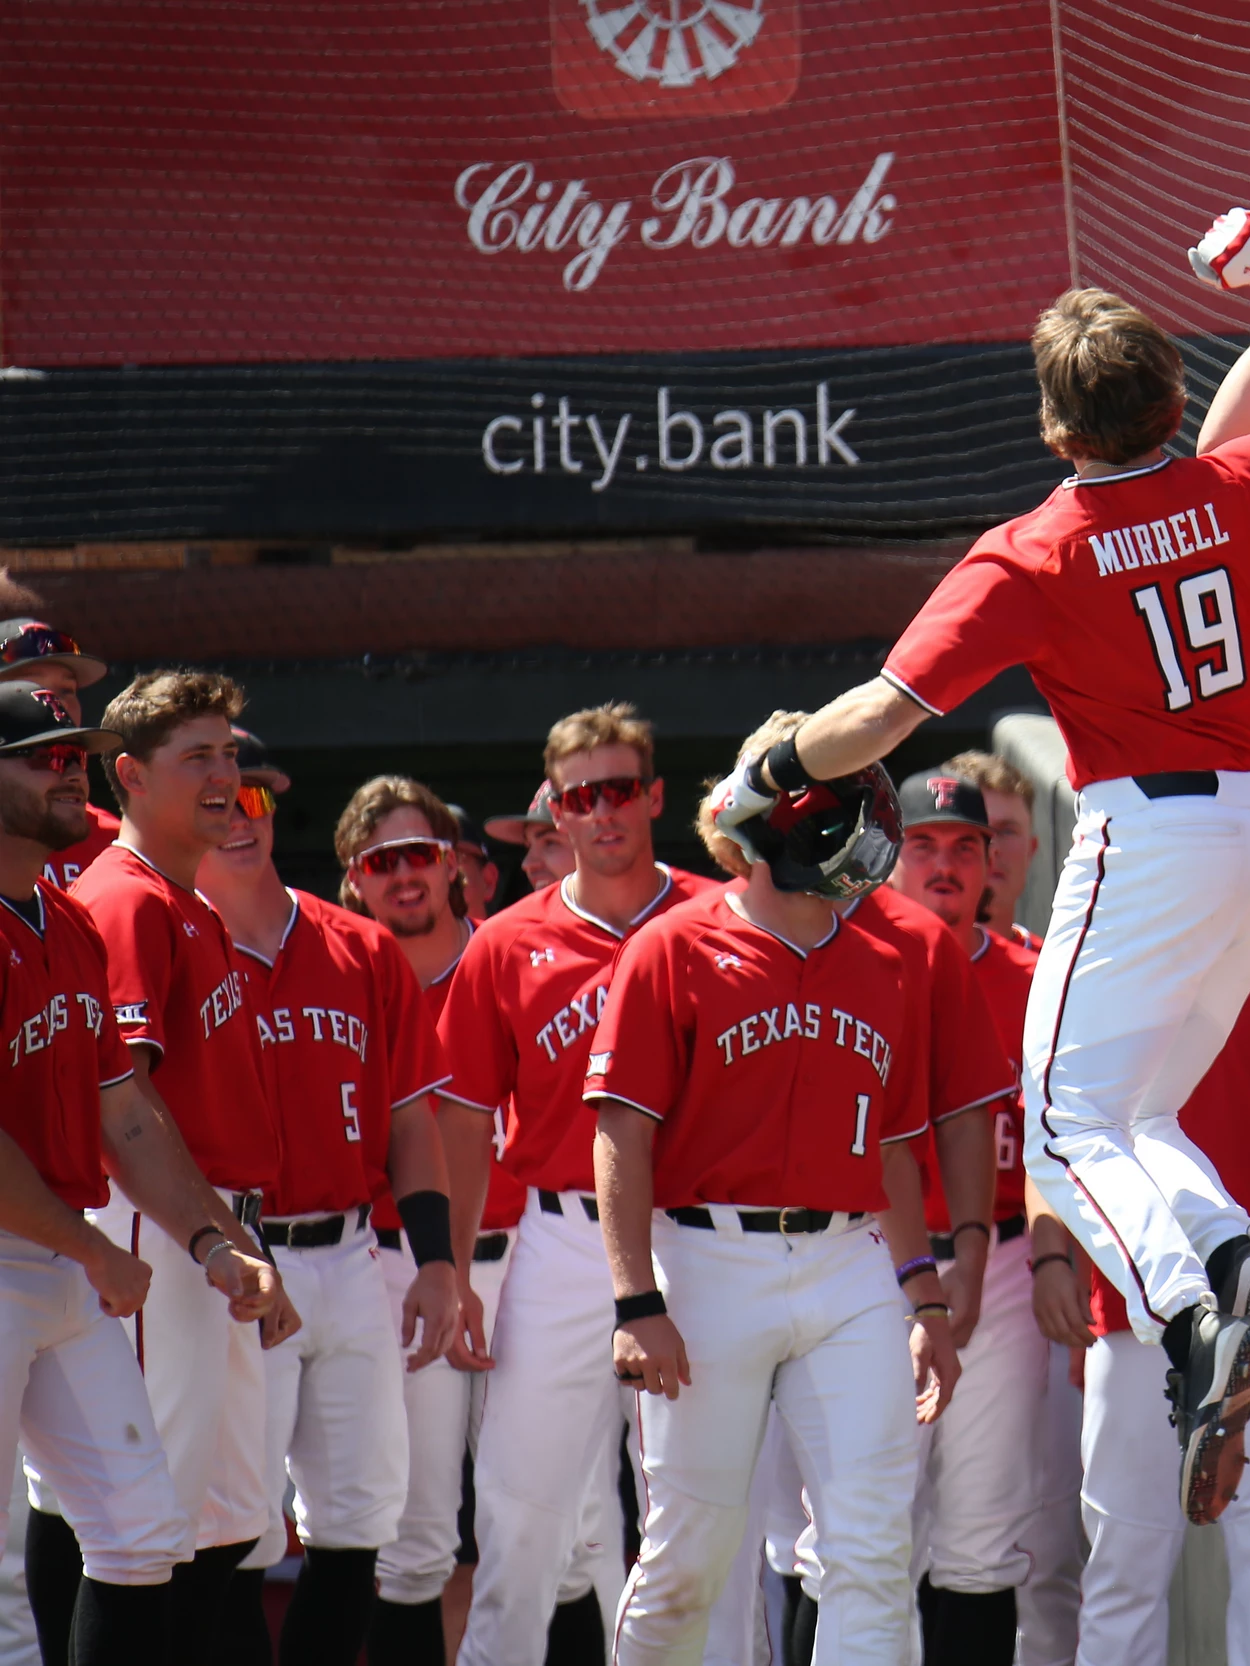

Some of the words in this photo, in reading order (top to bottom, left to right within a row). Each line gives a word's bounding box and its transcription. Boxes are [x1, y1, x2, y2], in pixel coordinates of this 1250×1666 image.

[454, 160, 632, 292] City
[640, 151, 897, 249] Bank
[481, 381, 861, 492] city.bank
[1087, 502, 1231, 578] MURRELL
[1129, 563, 1248, 714] 19
[303, 1007, 368, 1063] TECH
[535, 985, 608, 1063] TEXA
[717, 1003, 821, 1066] TEXAS
[832, 1007, 893, 1089] TECH
[341, 1082, 362, 1143] 5
[851, 1093, 872, 1158] 1
